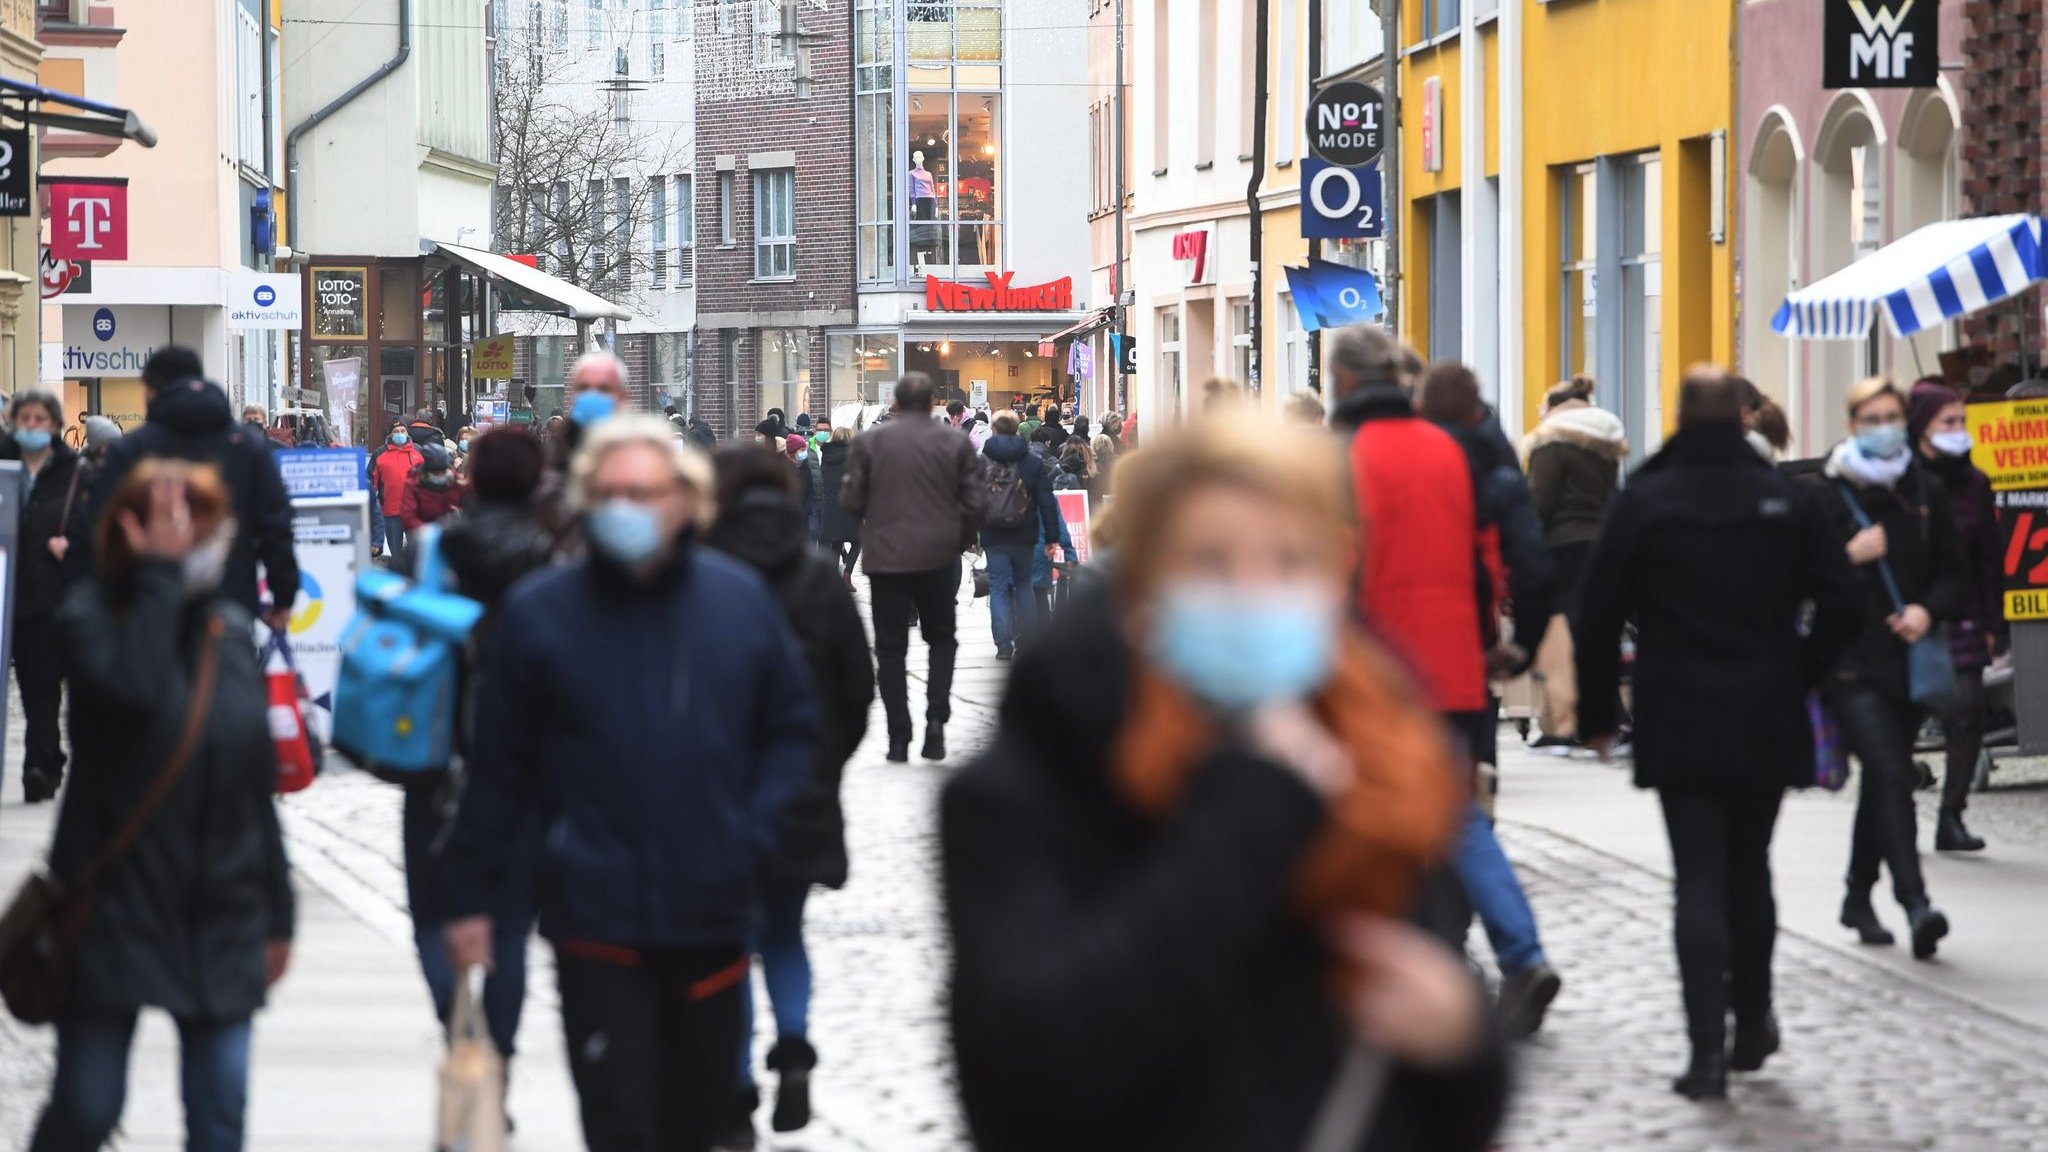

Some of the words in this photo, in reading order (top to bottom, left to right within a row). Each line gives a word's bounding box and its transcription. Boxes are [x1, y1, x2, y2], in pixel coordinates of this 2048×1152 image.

[1319, 132, 1377, 148] MODE
[231, 309, 298, 320] aktivschuh
[62, 346, 153, 371] tivschu
[476, 361, 509, 370] LOTTO
[1979, 417, 2048, 445] RÄUM
[2012, 593, 2048, 615] BIL
